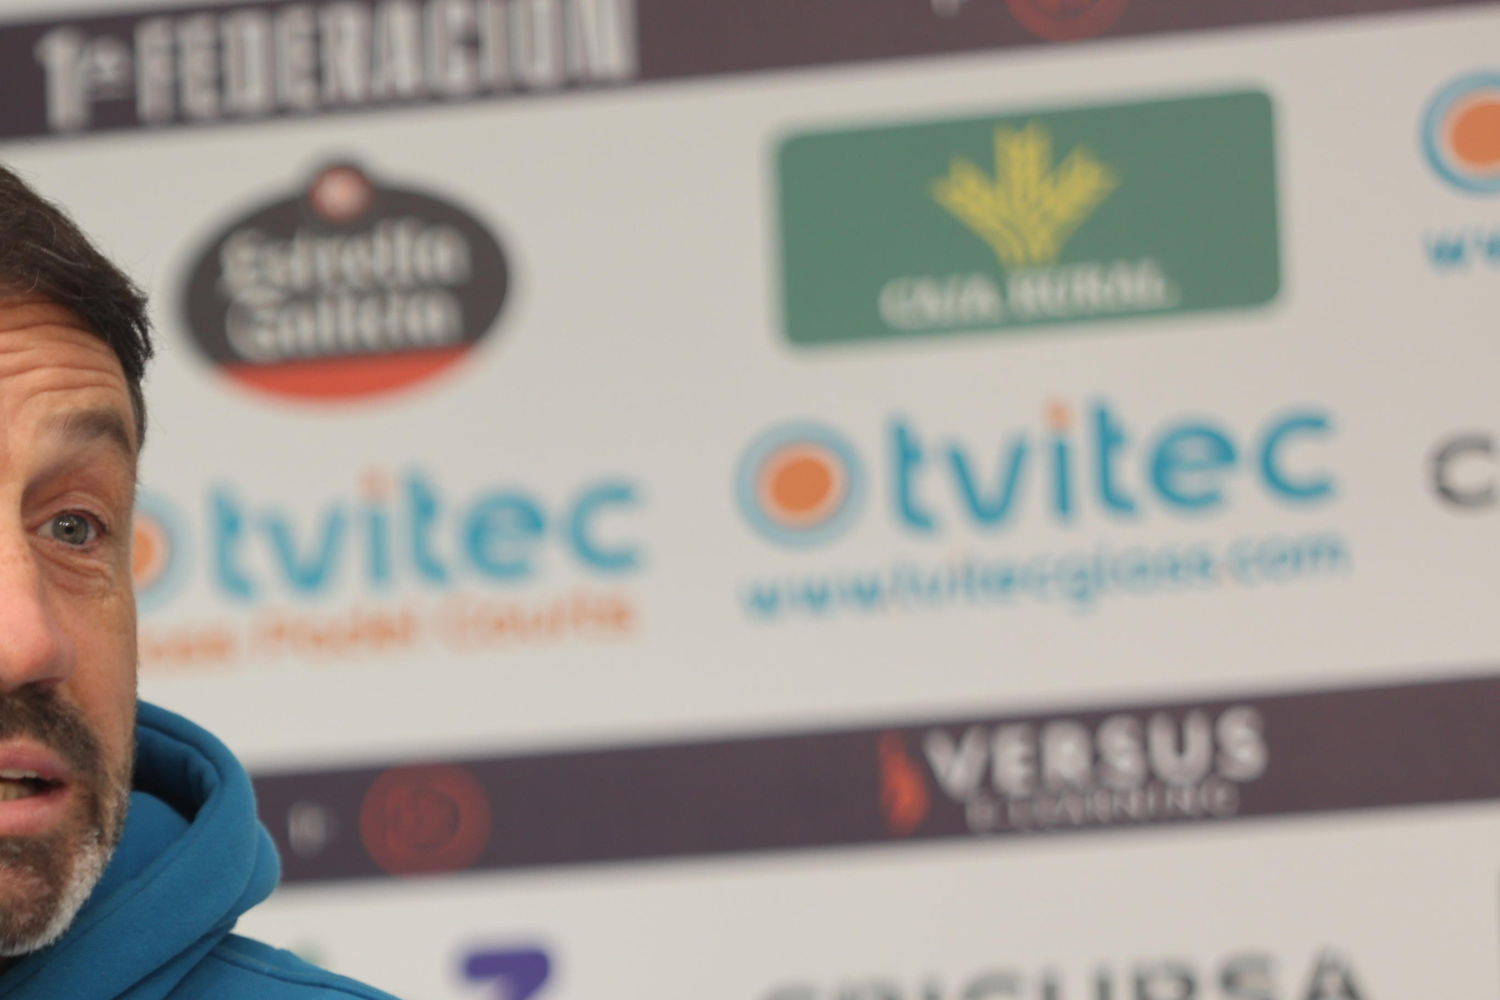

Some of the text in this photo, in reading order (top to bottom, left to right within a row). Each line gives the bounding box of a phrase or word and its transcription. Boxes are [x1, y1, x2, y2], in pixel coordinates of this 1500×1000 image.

[218, 217, 472, 298] Estrella
[226, 288, 462, 363] Galicia
[887, 397, 1340, 536] tvitec
[206, 467, 642, 602] tvitec
[922, 705, 1270, 801] VERSUS
